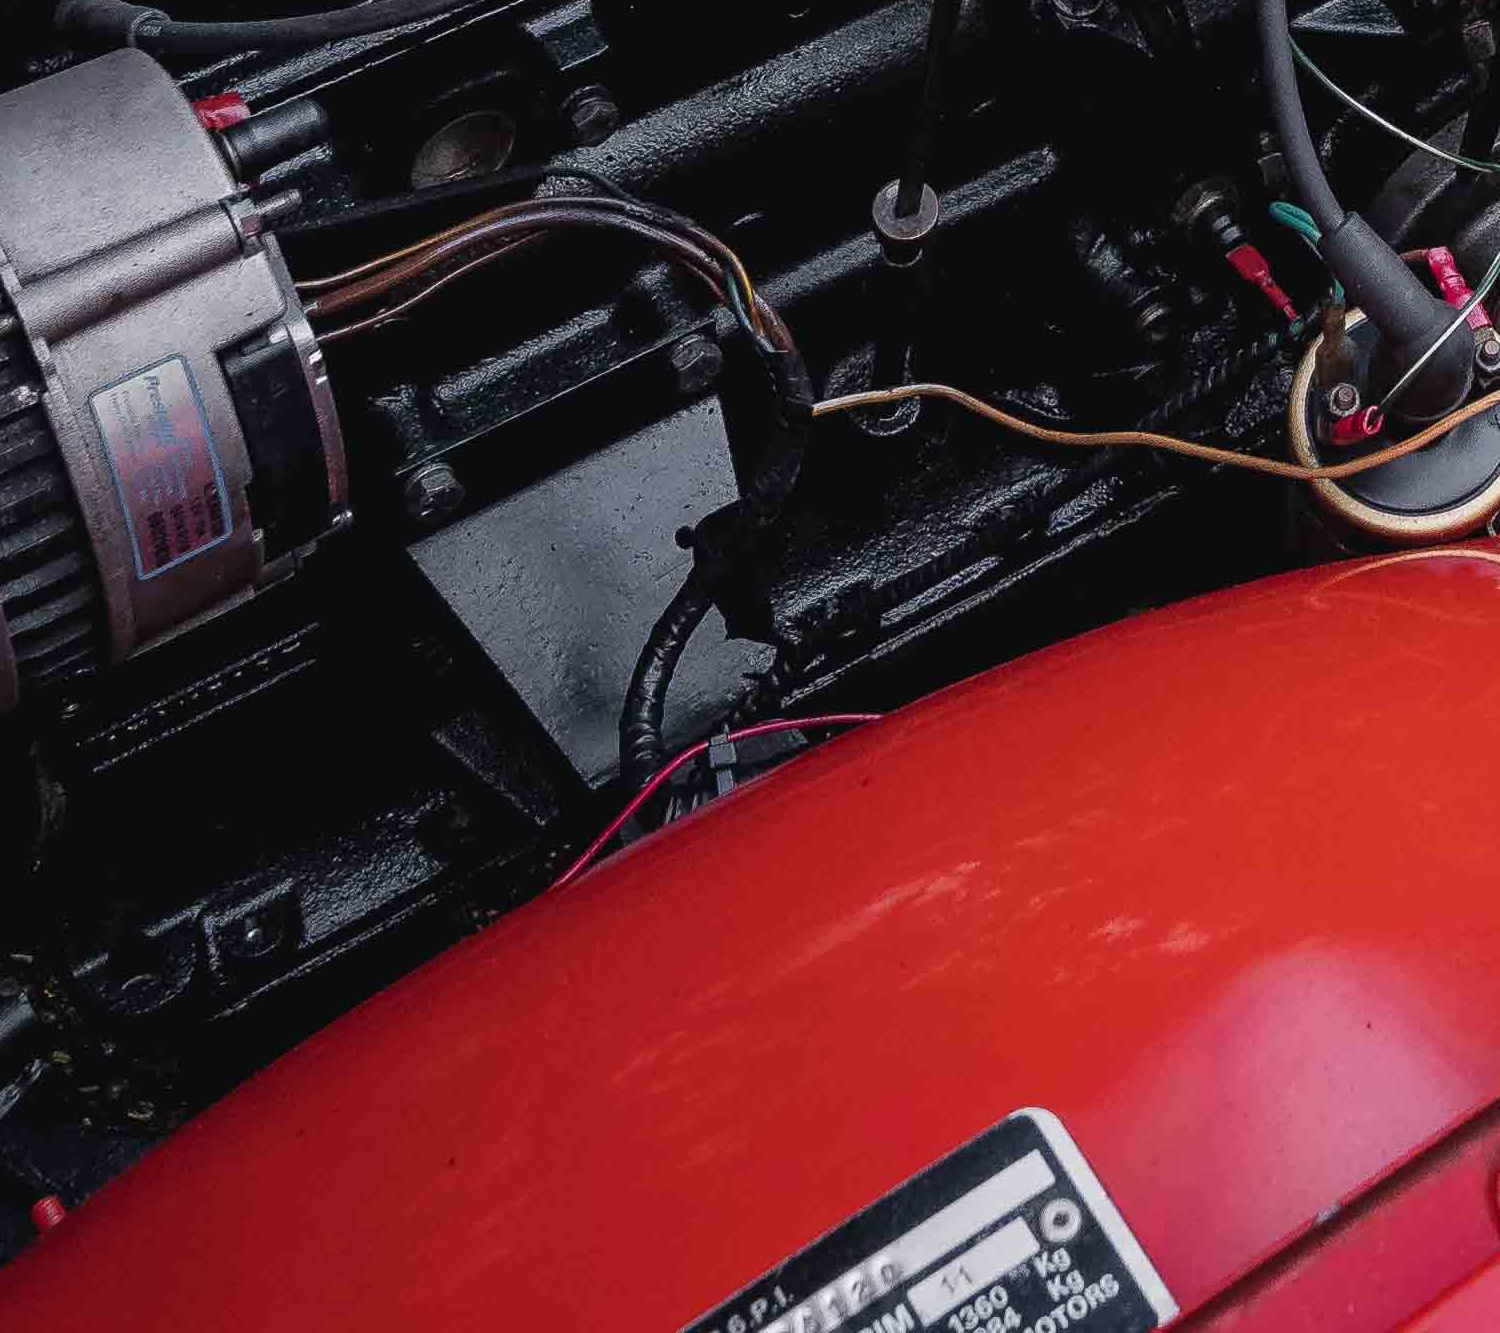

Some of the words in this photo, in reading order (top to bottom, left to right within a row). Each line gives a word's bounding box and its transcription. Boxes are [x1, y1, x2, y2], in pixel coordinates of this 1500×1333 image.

[947, 1285, 1010, 1333] 1360
[1031, 1247, 1073, 1278] Kg
[1022, 1274, 1121, 1333] OTORS
[1048, 1269, 1087, 1303] Kg
